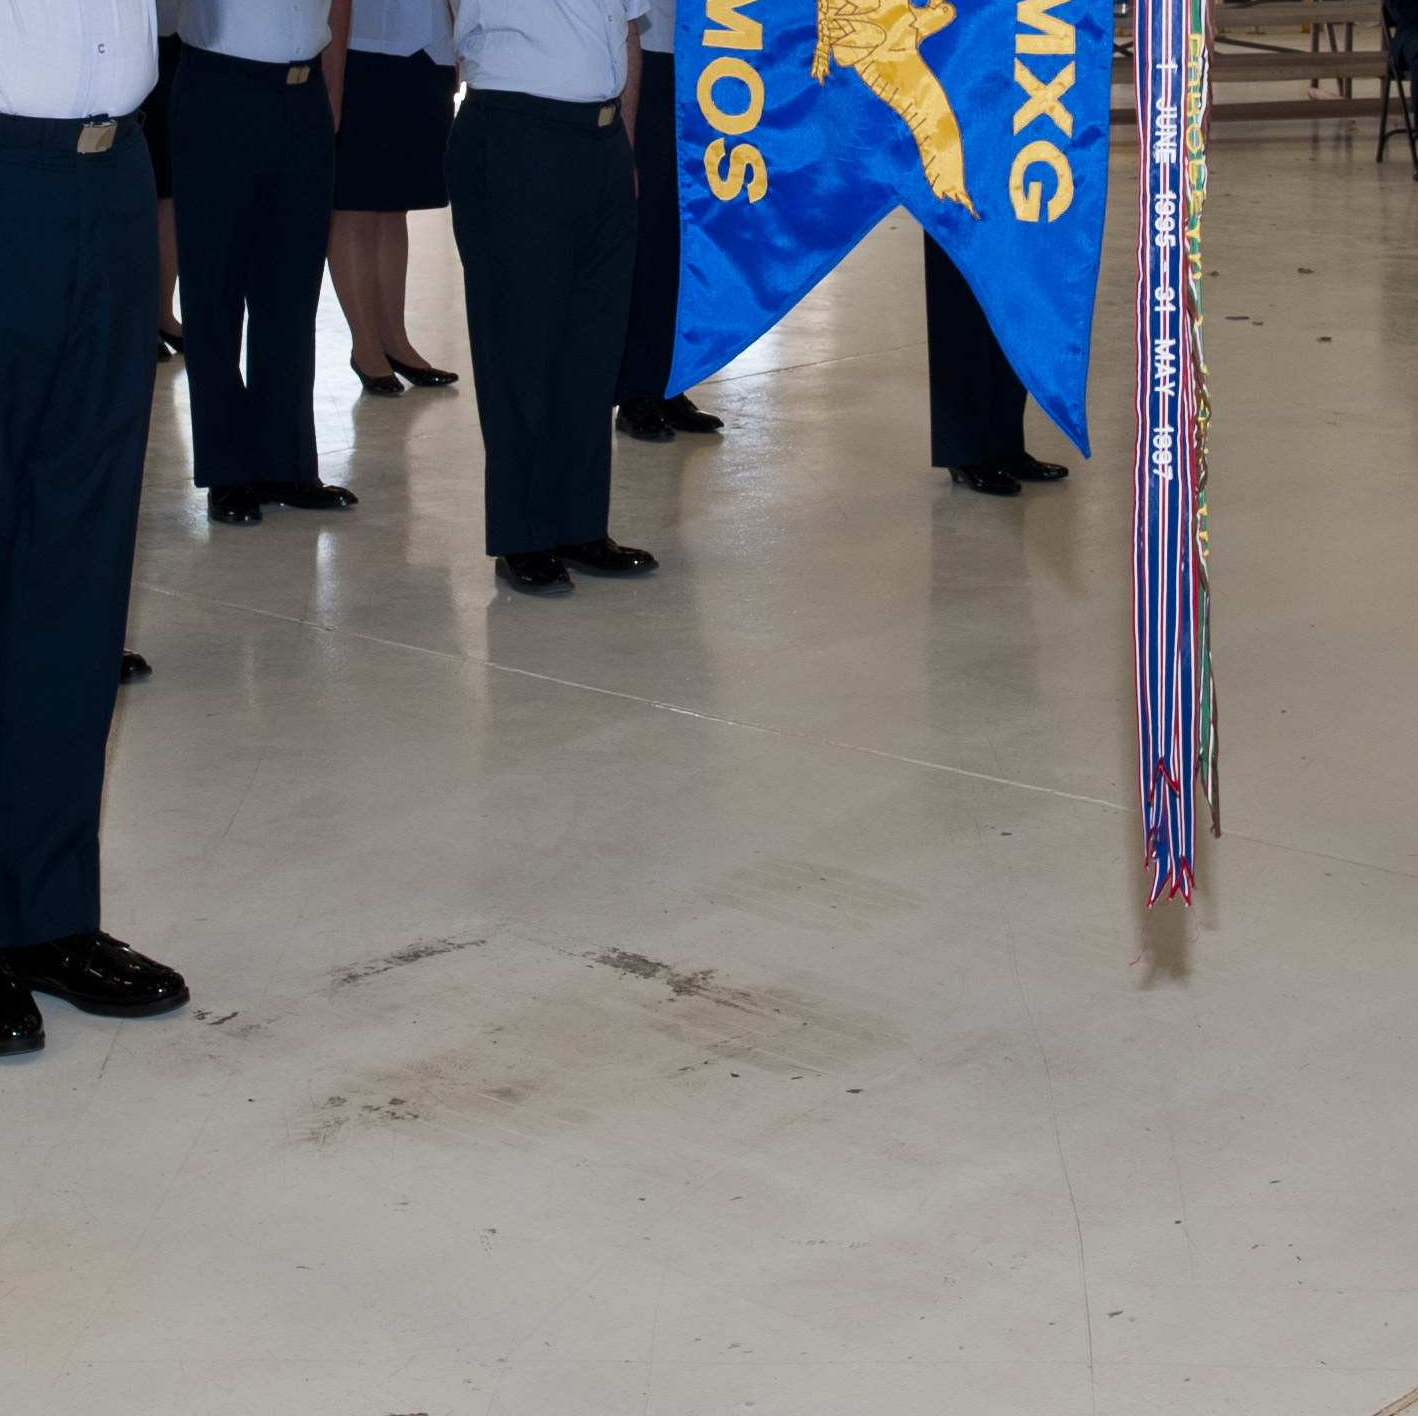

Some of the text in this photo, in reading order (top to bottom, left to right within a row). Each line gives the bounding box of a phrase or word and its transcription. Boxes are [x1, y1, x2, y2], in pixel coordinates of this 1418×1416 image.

[1156, 61, 1178, 70] 1
[1154, 98, 1178, 164] JUNE
[1155, 191, 1176, 248] 1995
[1154, 286, 1175, 313] 31
[1154, 339, 1175, 396] MAY
[1153, 426, 1174, 481] 1997
